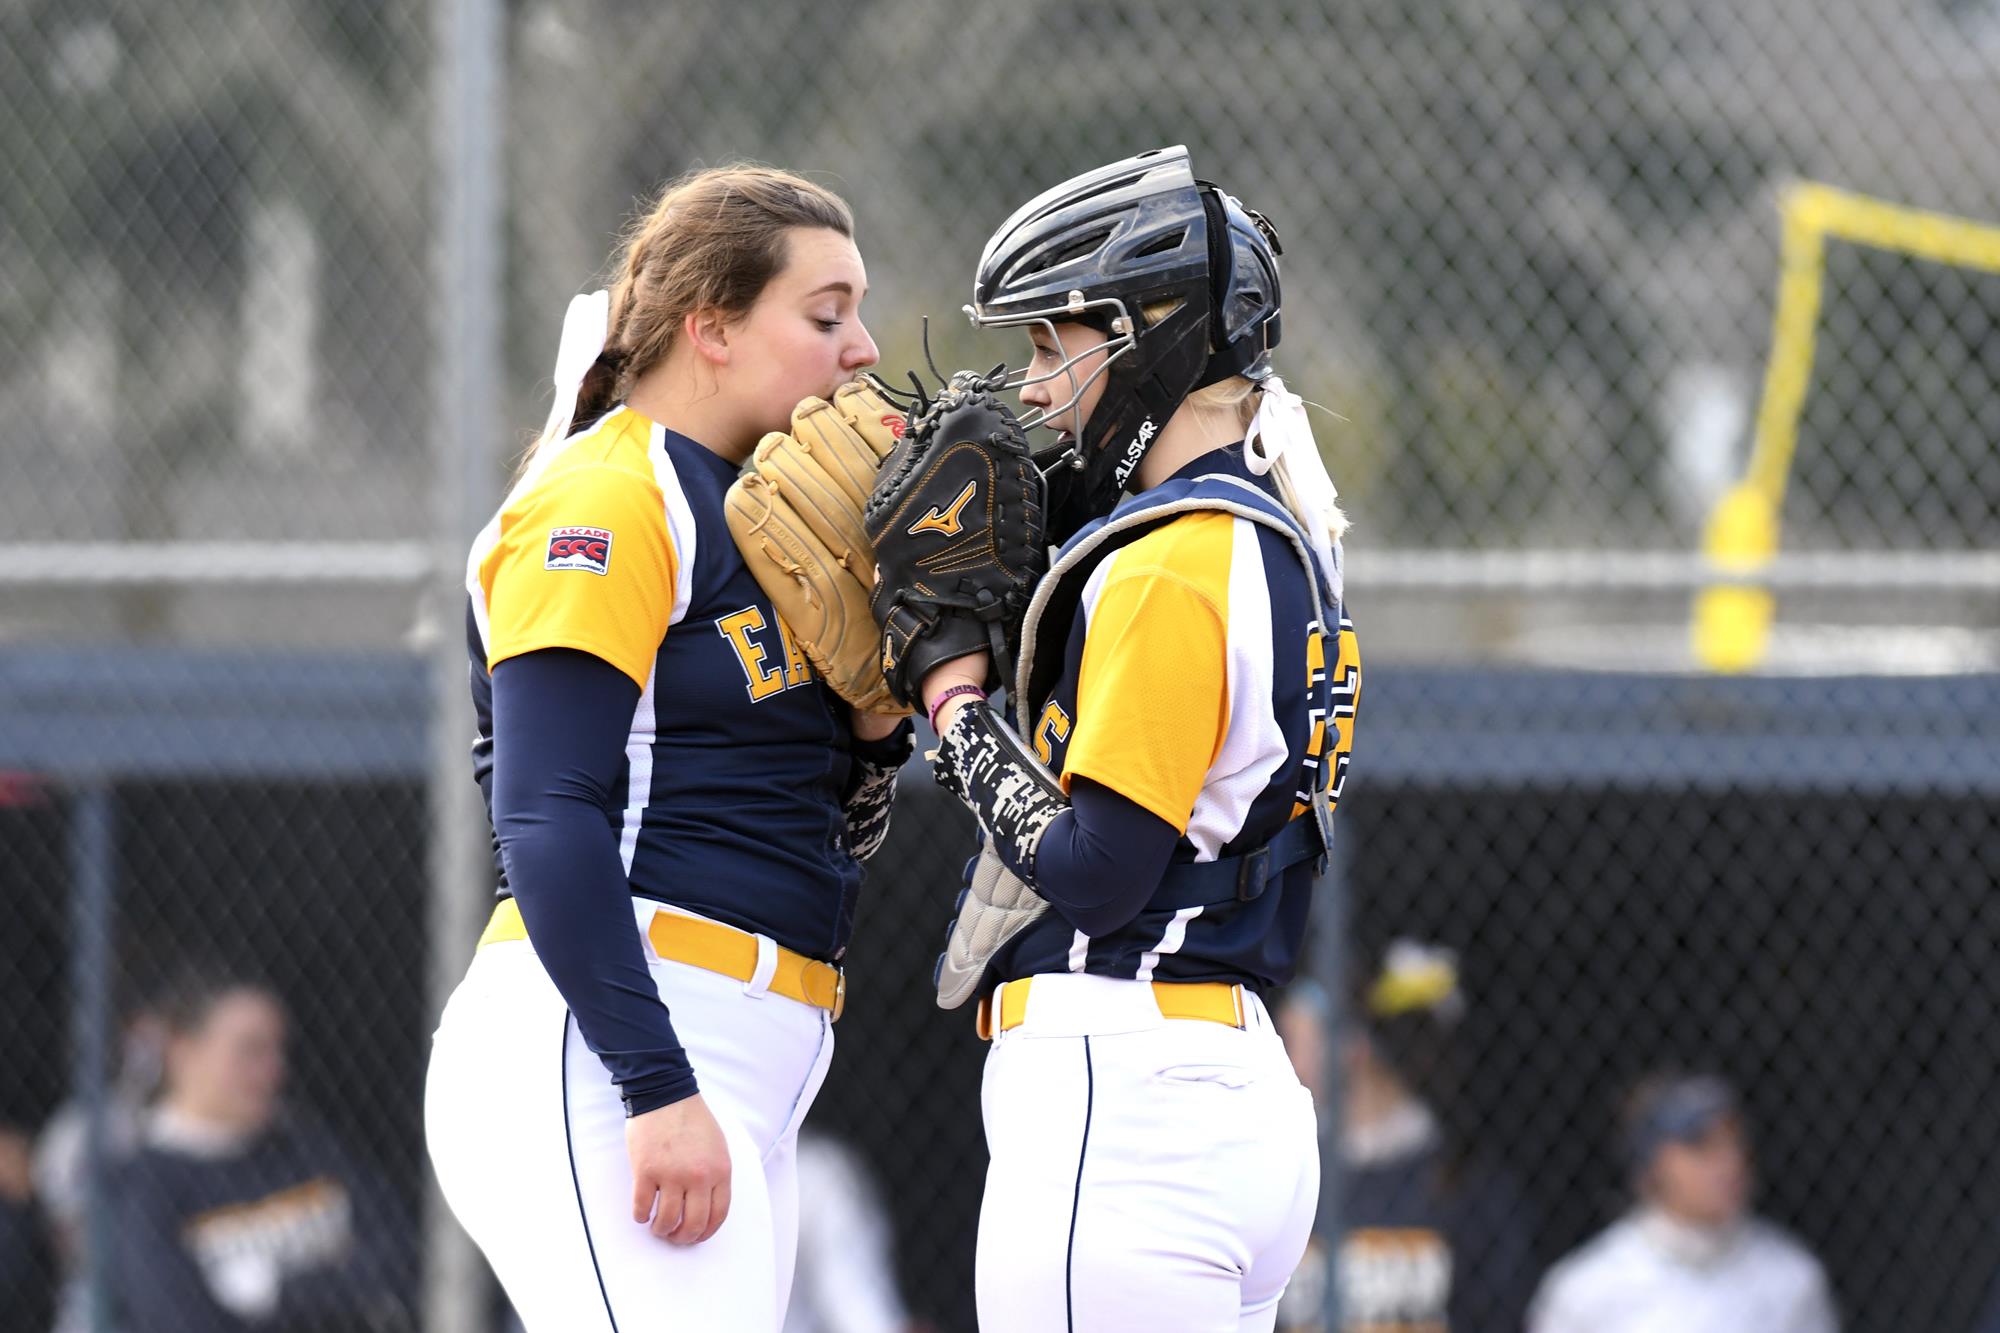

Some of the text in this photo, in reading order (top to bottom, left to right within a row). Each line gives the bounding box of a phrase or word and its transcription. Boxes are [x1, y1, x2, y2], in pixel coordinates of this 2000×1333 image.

[1115, 420, 1158, 489] ALL-STAR
[552, 528, 610, 539] CASCADE
[550, 539, 607, 560] CCC
